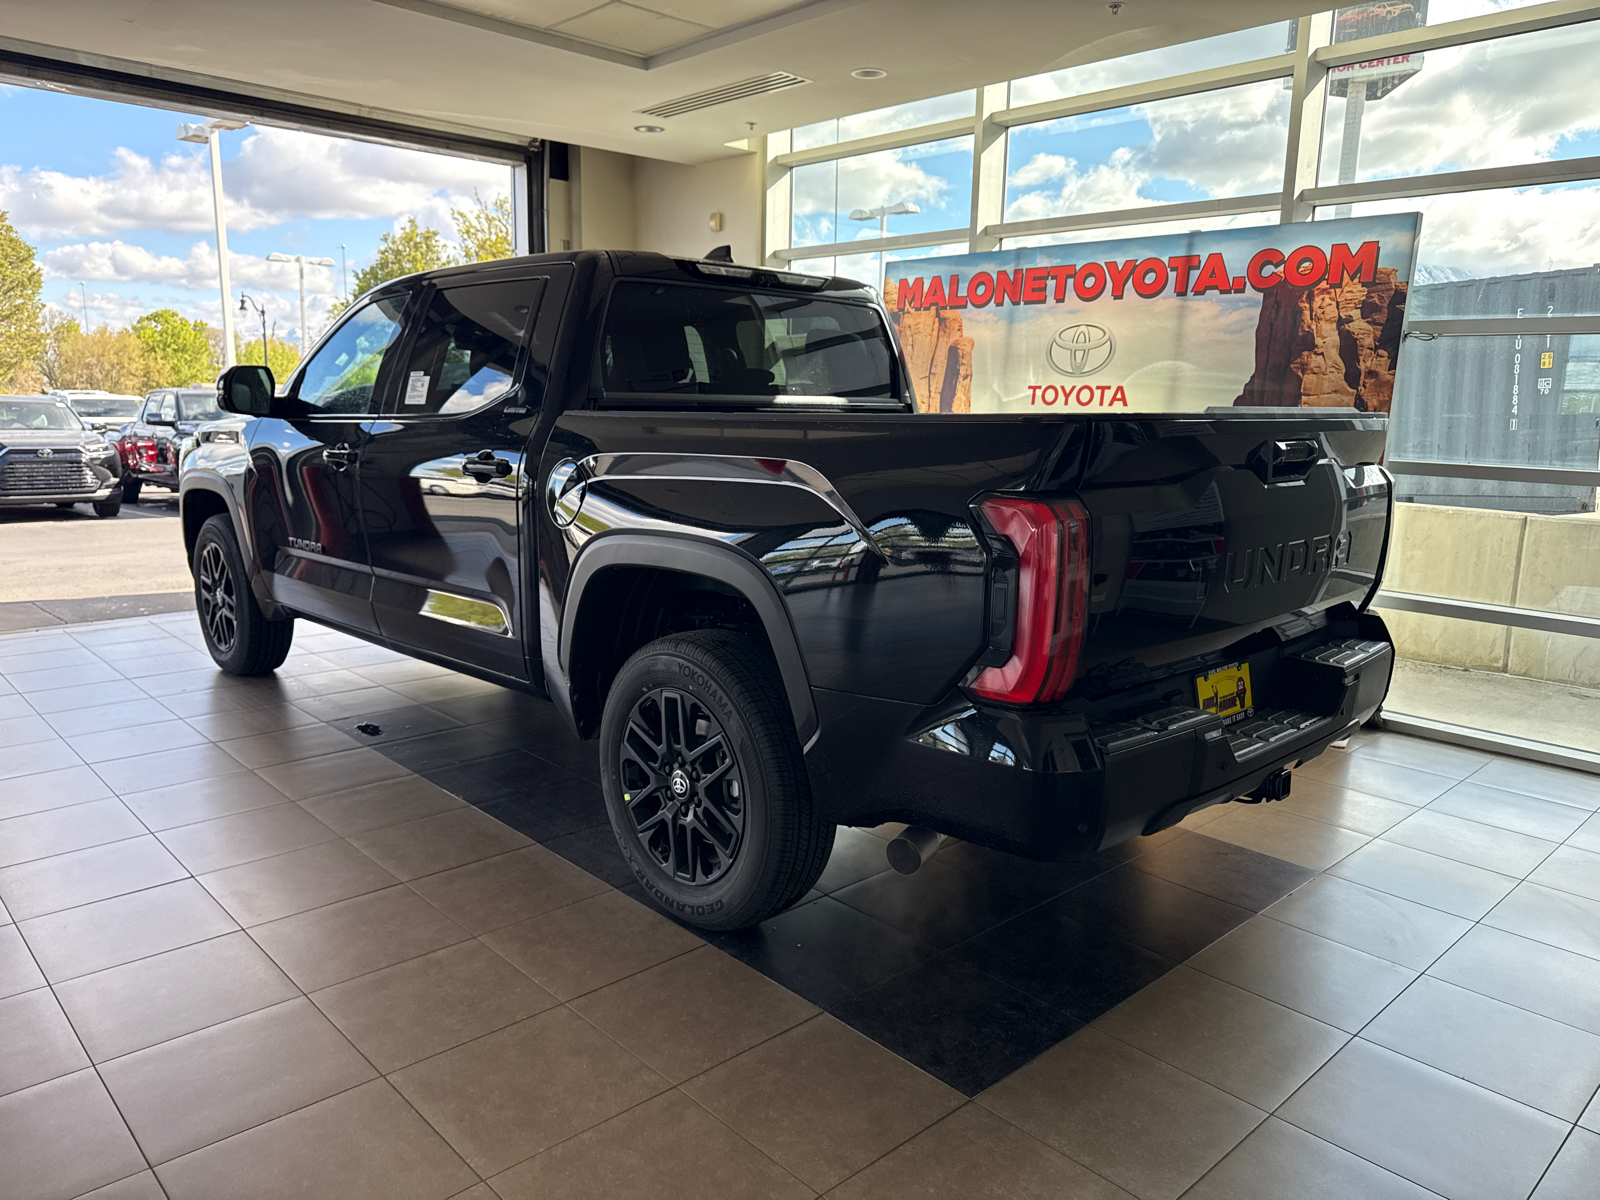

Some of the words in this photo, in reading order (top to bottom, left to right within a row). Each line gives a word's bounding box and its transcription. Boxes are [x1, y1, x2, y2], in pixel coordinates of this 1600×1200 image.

[897, 240, 1381, 312] MALONETOYOTA.COM
[1027, 384, 1128, 408] TOYOTA
[288, 536, 323, 554] TUNDRA
[678, 662, 732, 722] YOKOHAMA
[635, 867, 725, 916] GEOLANDAR
